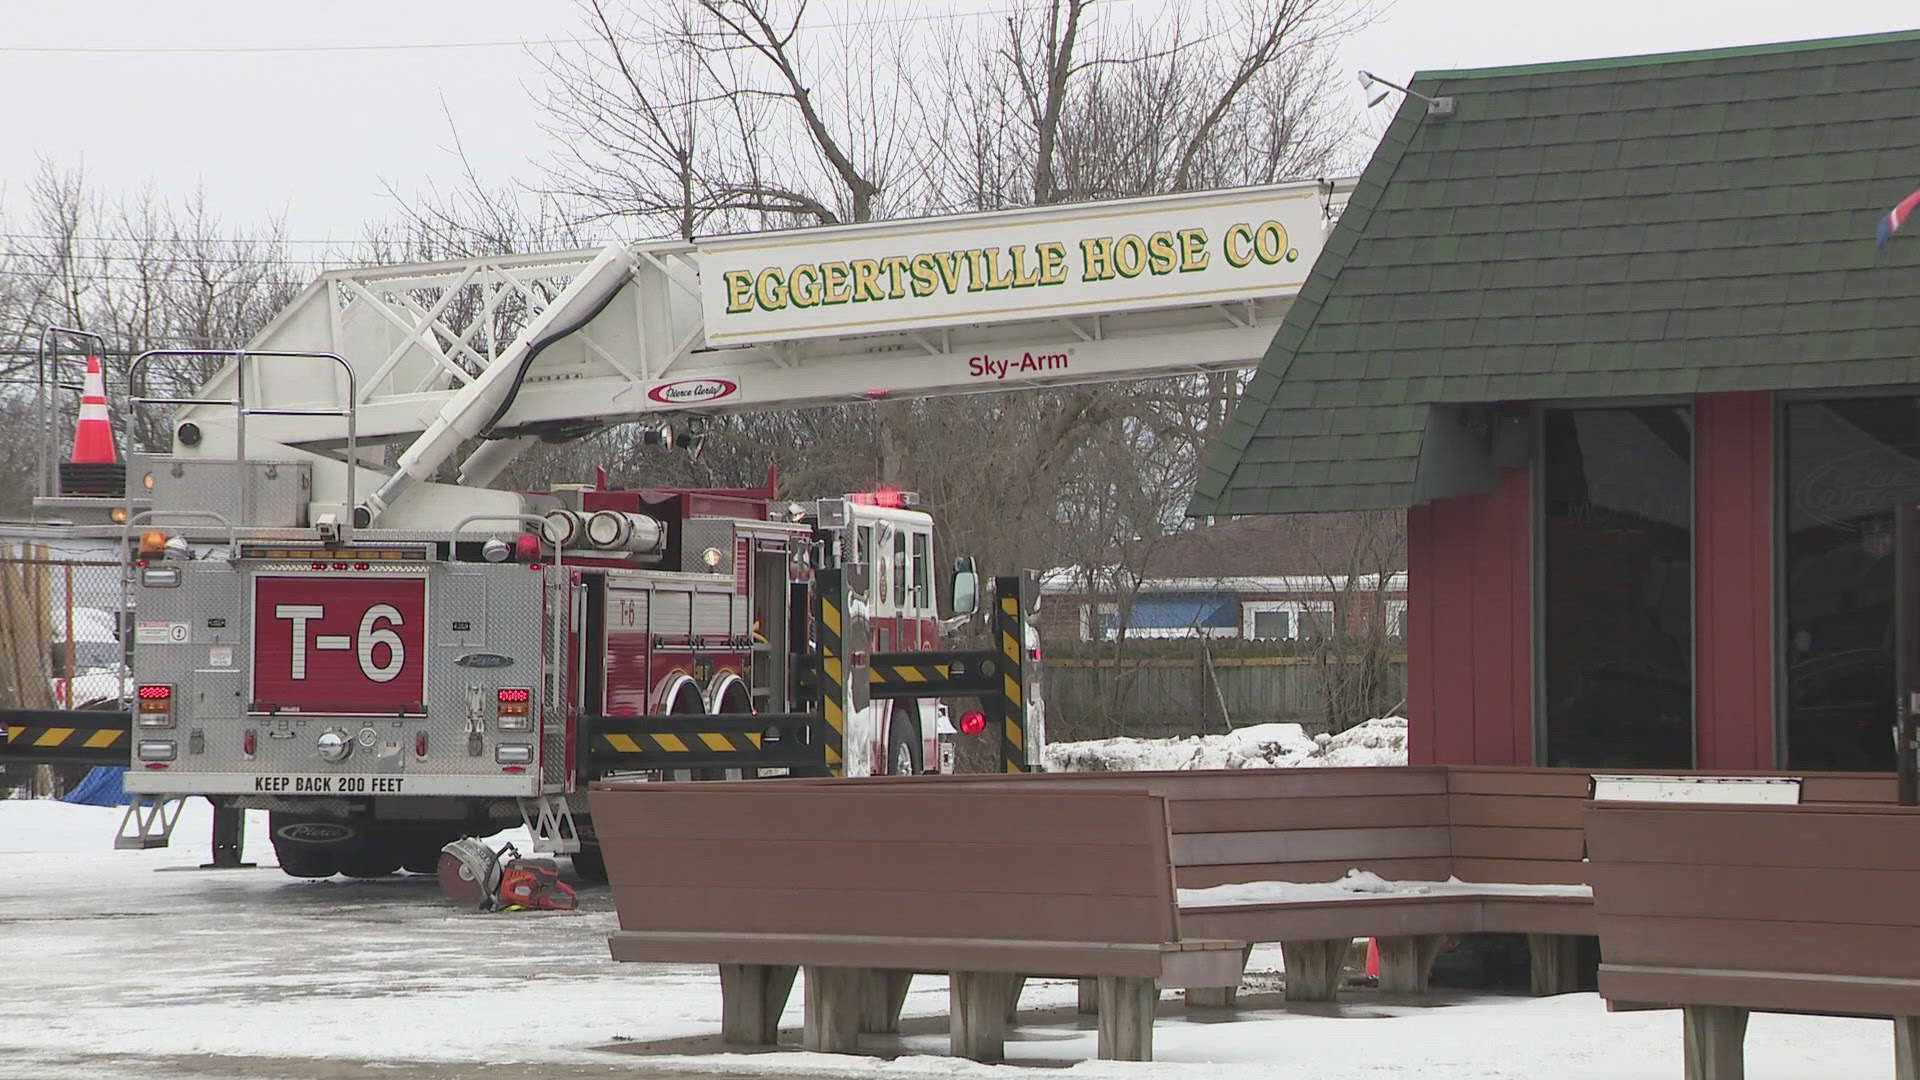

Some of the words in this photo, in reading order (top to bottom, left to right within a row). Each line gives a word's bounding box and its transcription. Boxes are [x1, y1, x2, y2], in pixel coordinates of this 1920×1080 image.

[724, 241, 1068, 314] EGGERTSVILLE
[1080, 228, 1211, 282] HOSE
[1224, 220, 1299, 269] CO.
[968, 352, 1068, 380] Sky-Arm
[665, 386, 692, 400] Pierce
[619, 599, 635, 628] T-6
[275, 603, 406, 684] T-6
[255, 776, 290, 792] KEEP
[295, 777, 332, 792] BACK
[338, 777, 366, 792] 200
[371, 778, 404, 792] FEET
